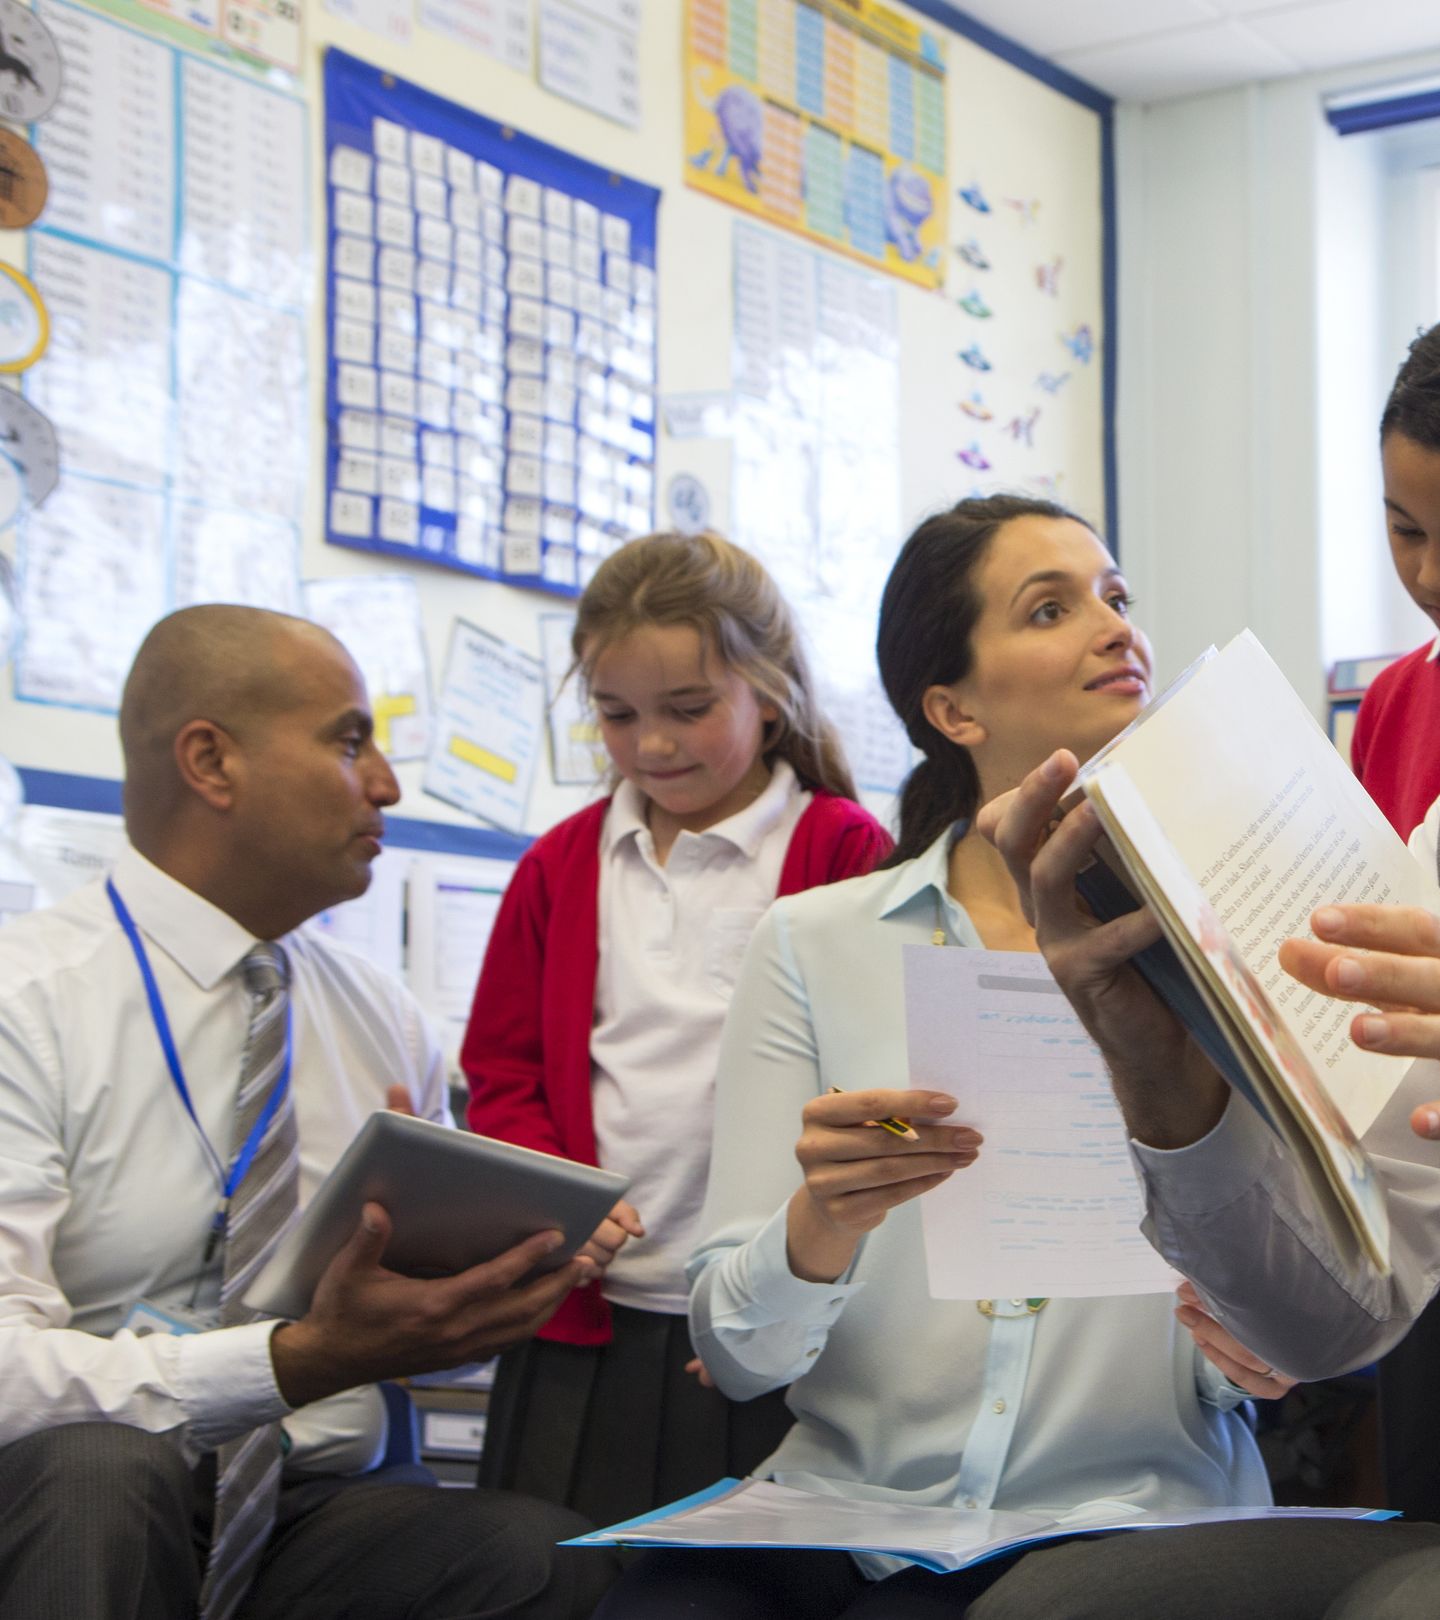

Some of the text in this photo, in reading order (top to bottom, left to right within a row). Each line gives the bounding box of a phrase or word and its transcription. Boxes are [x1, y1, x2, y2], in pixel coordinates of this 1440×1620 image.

[1206, 860, 1224, 878] Little
[1223, 840, 1244, 861] Caribou
[1220, 884, 1228, 893] to
[1239, 856, 1255, 873] Sharp
[1264, 832, 1274, 843] kill
[1277, 819, 1286, 829] the
[1230, 924, 1245, 937] The
[1245, 903, 1264, 926] caribou
[1262, 890, 1275, 905] feast
[1274, 882, 1282, 892] on
[1278, 868, 1294, 884] leaves
[1292, 856, 1302, 869] and
[1310, 830, 1323, 844] Little
[1233, 898, 1242, 907] to
[1240, 886, 1251, 900] red
[1250, 876, 1261, 890] and
[1259, 926, 1269, 937] the
[1281, 898, 1293, 910] but
[1291, 889, 1300, 900] she
[1298, 879, 1309, 891] does
[1307, 869, 1316, 880] not
[1284, 923, 1297, 937] bulls
[1302, 905, 1311, 916] the
[1265, 974, 1279, 990] than
[1277, 992, 1288, 1006] All
[1286, 983, 1296, 995] the
[1313, 1005, 1328, 1021] Soon
[1313, 1008, 1348, 1053] for the caribou
[1326, 1038, 1348, 1067] they will
